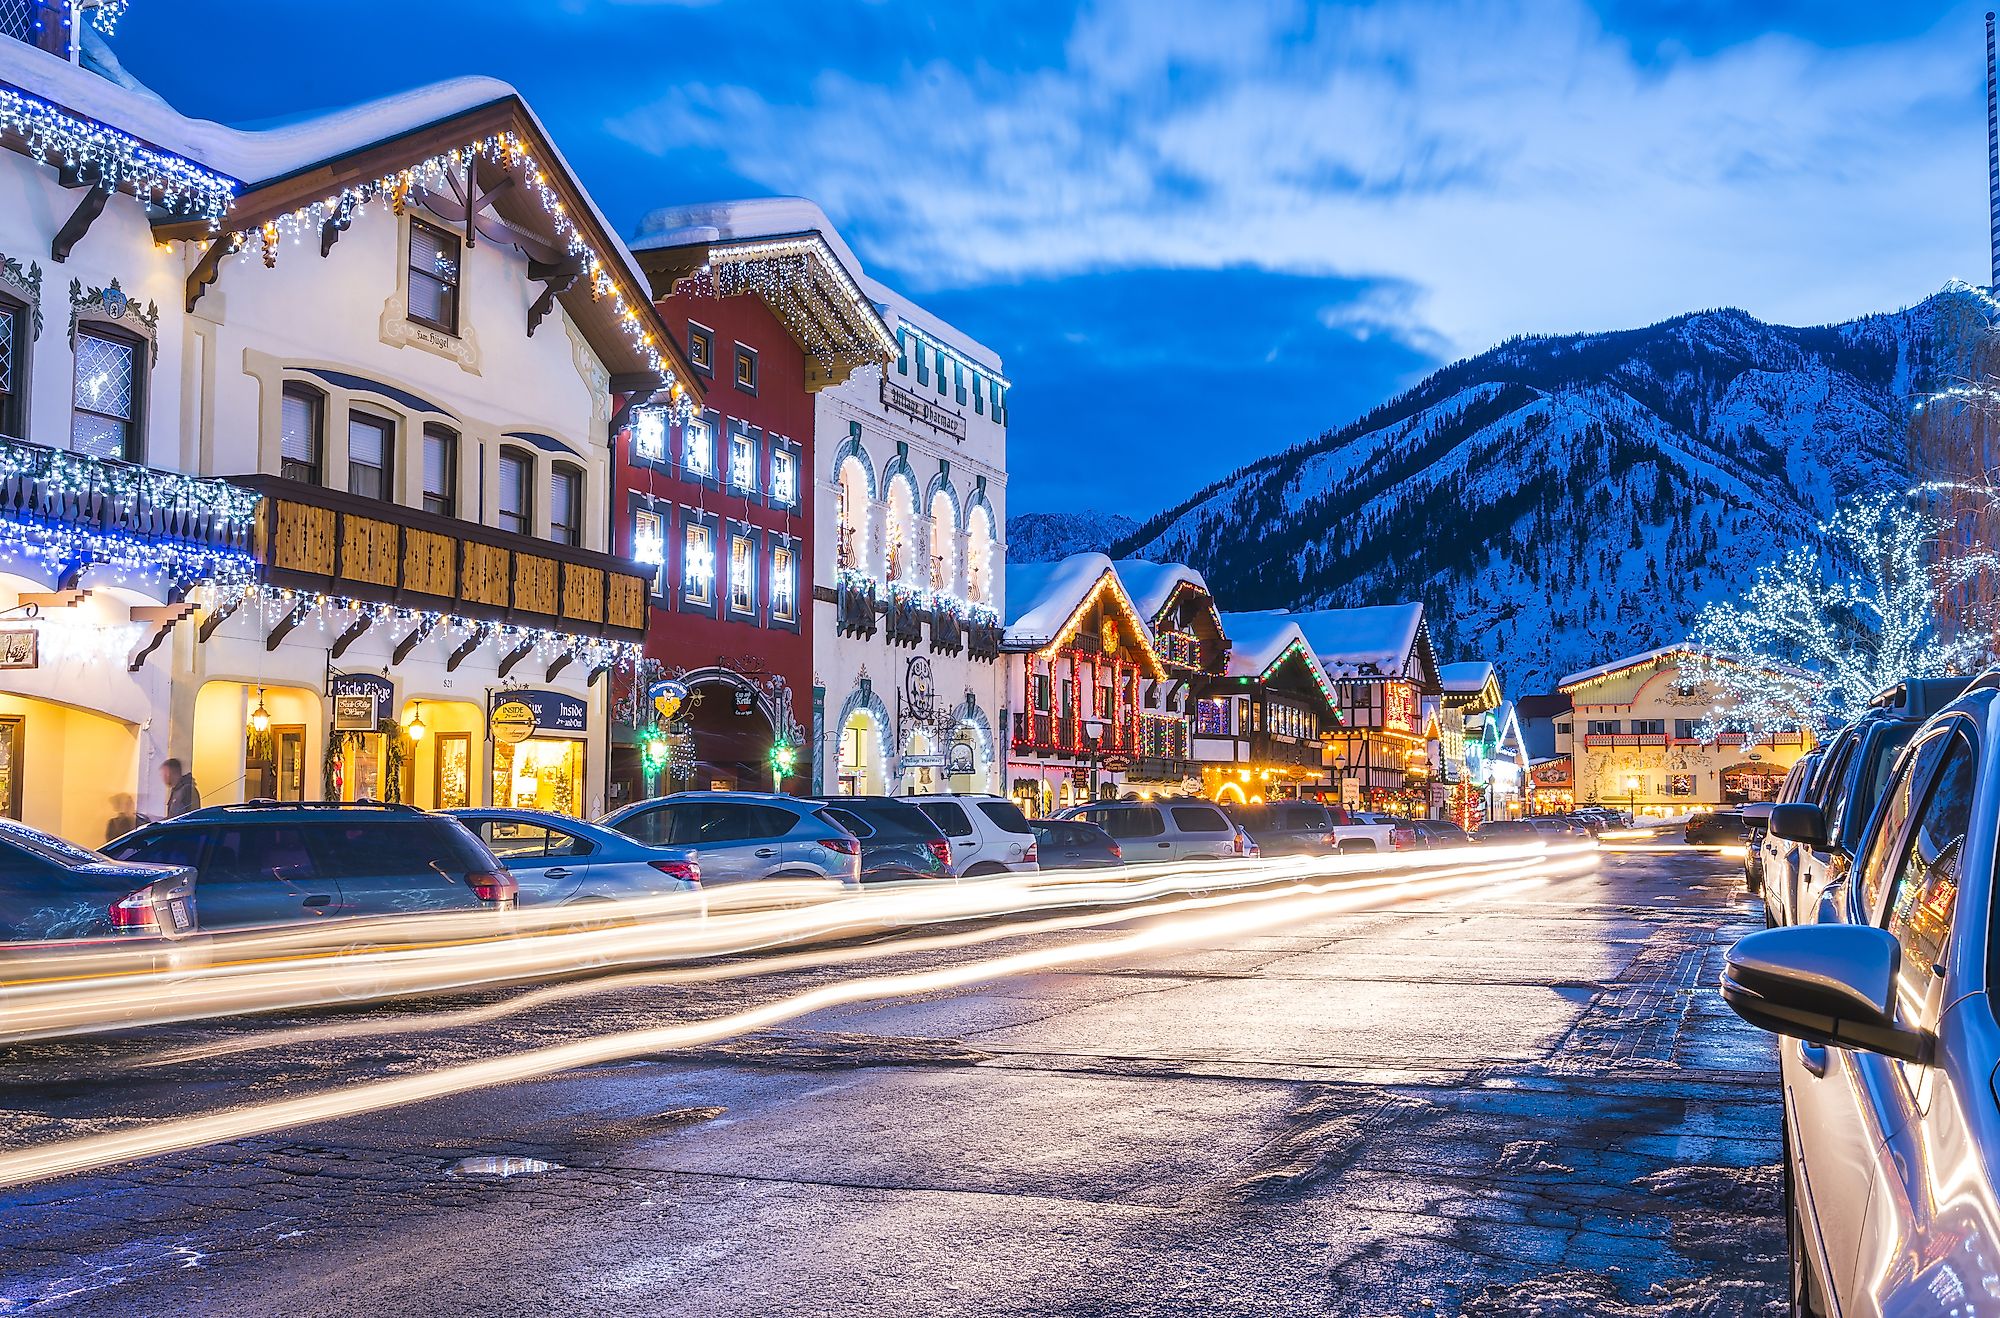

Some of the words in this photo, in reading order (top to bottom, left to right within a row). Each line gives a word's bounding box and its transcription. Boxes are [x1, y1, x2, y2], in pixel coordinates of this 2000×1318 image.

[891, 388, 919, 415] Village
[923, 403, 959, 432] Pharmacy
[502, 706, 524, 714] INSIDE
[560, 702, 583, 717] Inside
